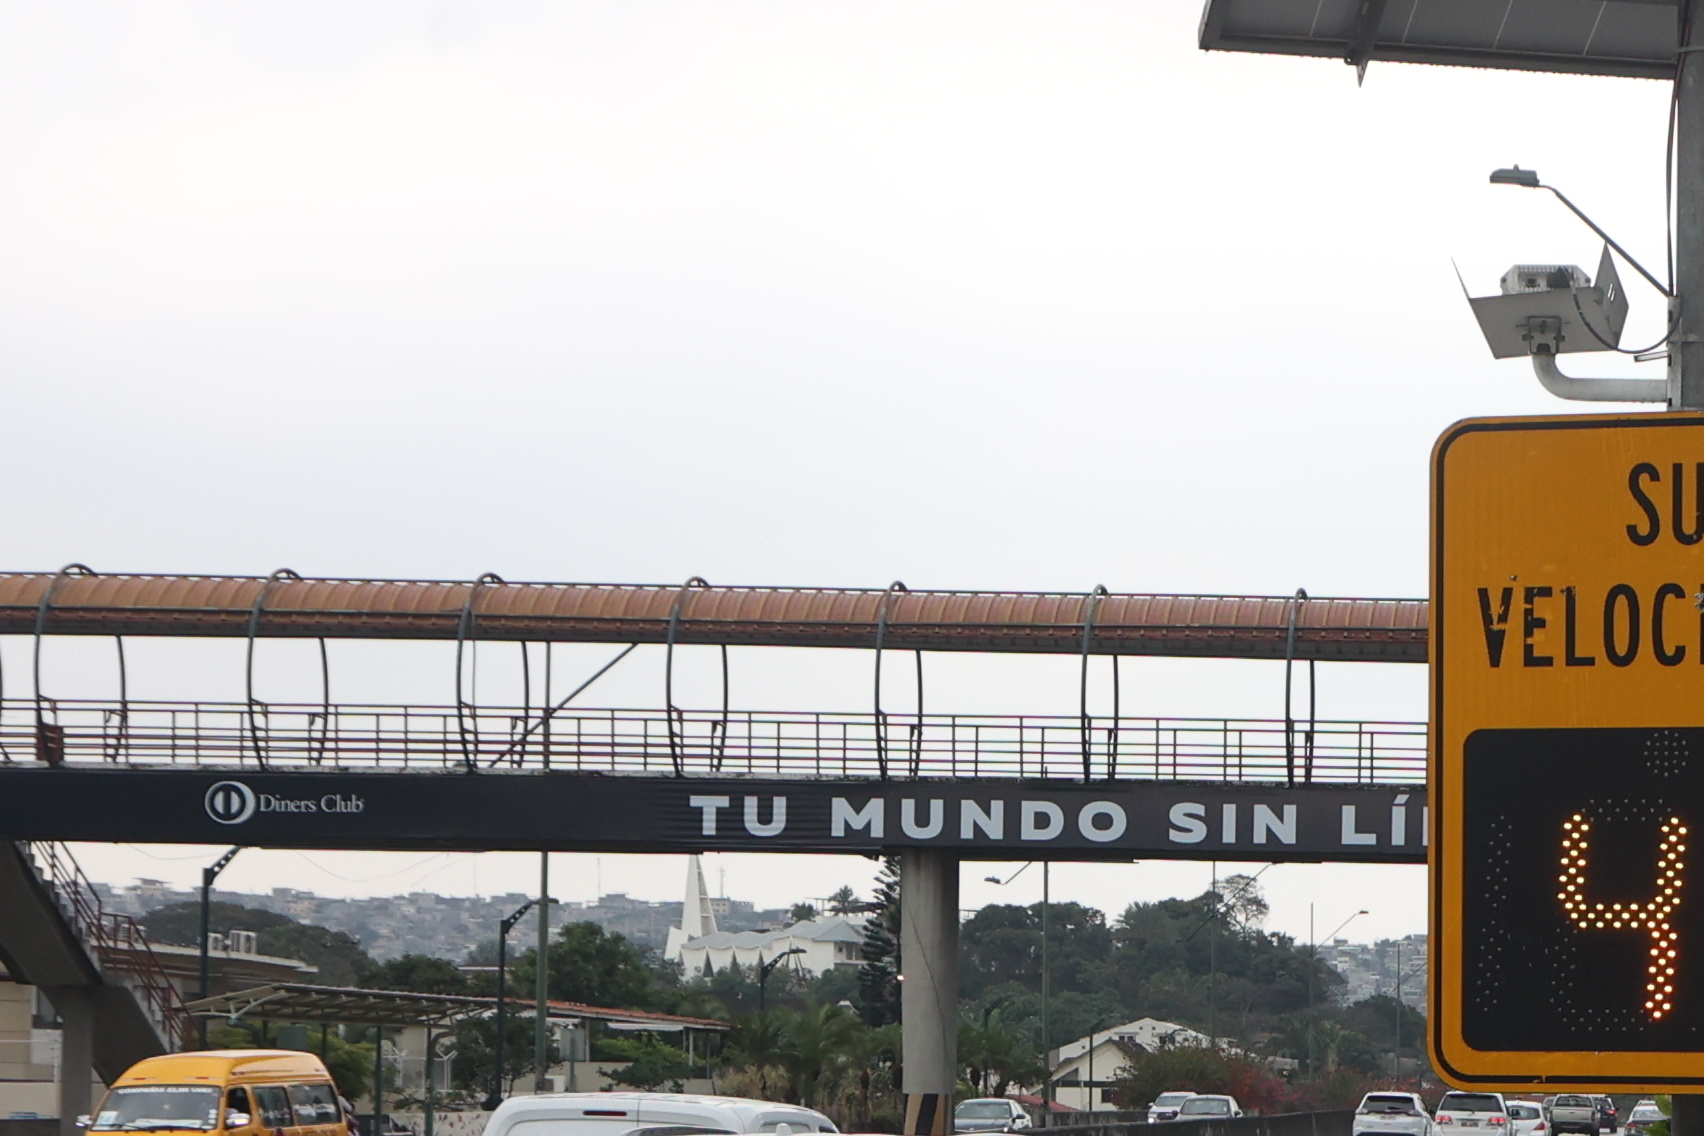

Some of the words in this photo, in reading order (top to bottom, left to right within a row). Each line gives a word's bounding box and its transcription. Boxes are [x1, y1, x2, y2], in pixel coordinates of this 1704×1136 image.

[259, 794, 317, 813] Diners
[320, 794, 364, 813] Club
[689, 795, 788, 837] TU
[831, 797, 1128, 843] MUNDO
[1168, 801, 1298, 845] SIN
[1340, 794, 1429, 846] LÍ
